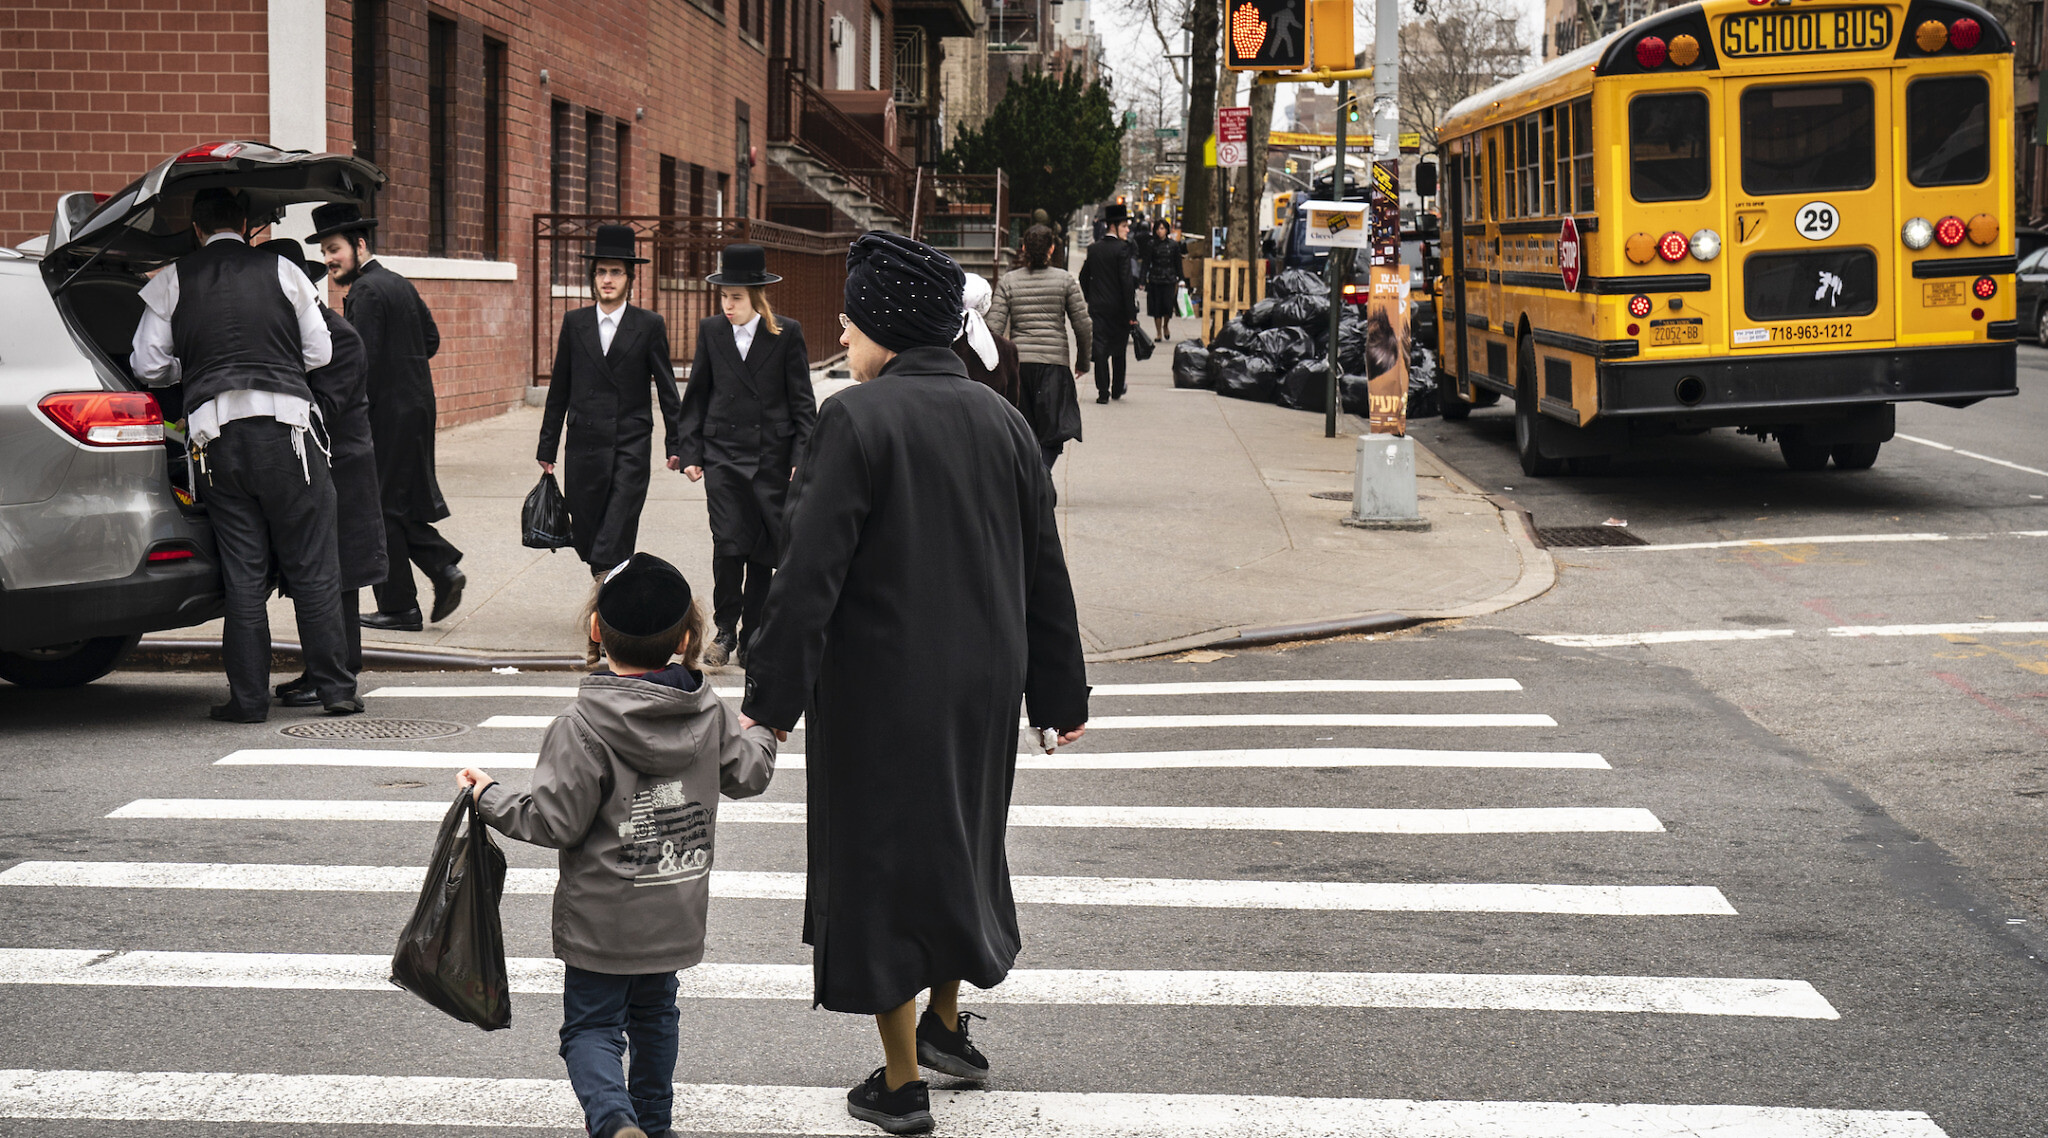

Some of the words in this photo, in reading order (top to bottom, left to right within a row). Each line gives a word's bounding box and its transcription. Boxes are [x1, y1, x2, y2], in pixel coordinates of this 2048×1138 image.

[1727, 13, 1827, 54] SCHOOL
[1834, 9, 1885, 49] BUS
[1804, 208, 1833, 232] 29
[1562, 241, 1577, 269] STOP
[1771, 323, 1852, 341] 718-963-1212
